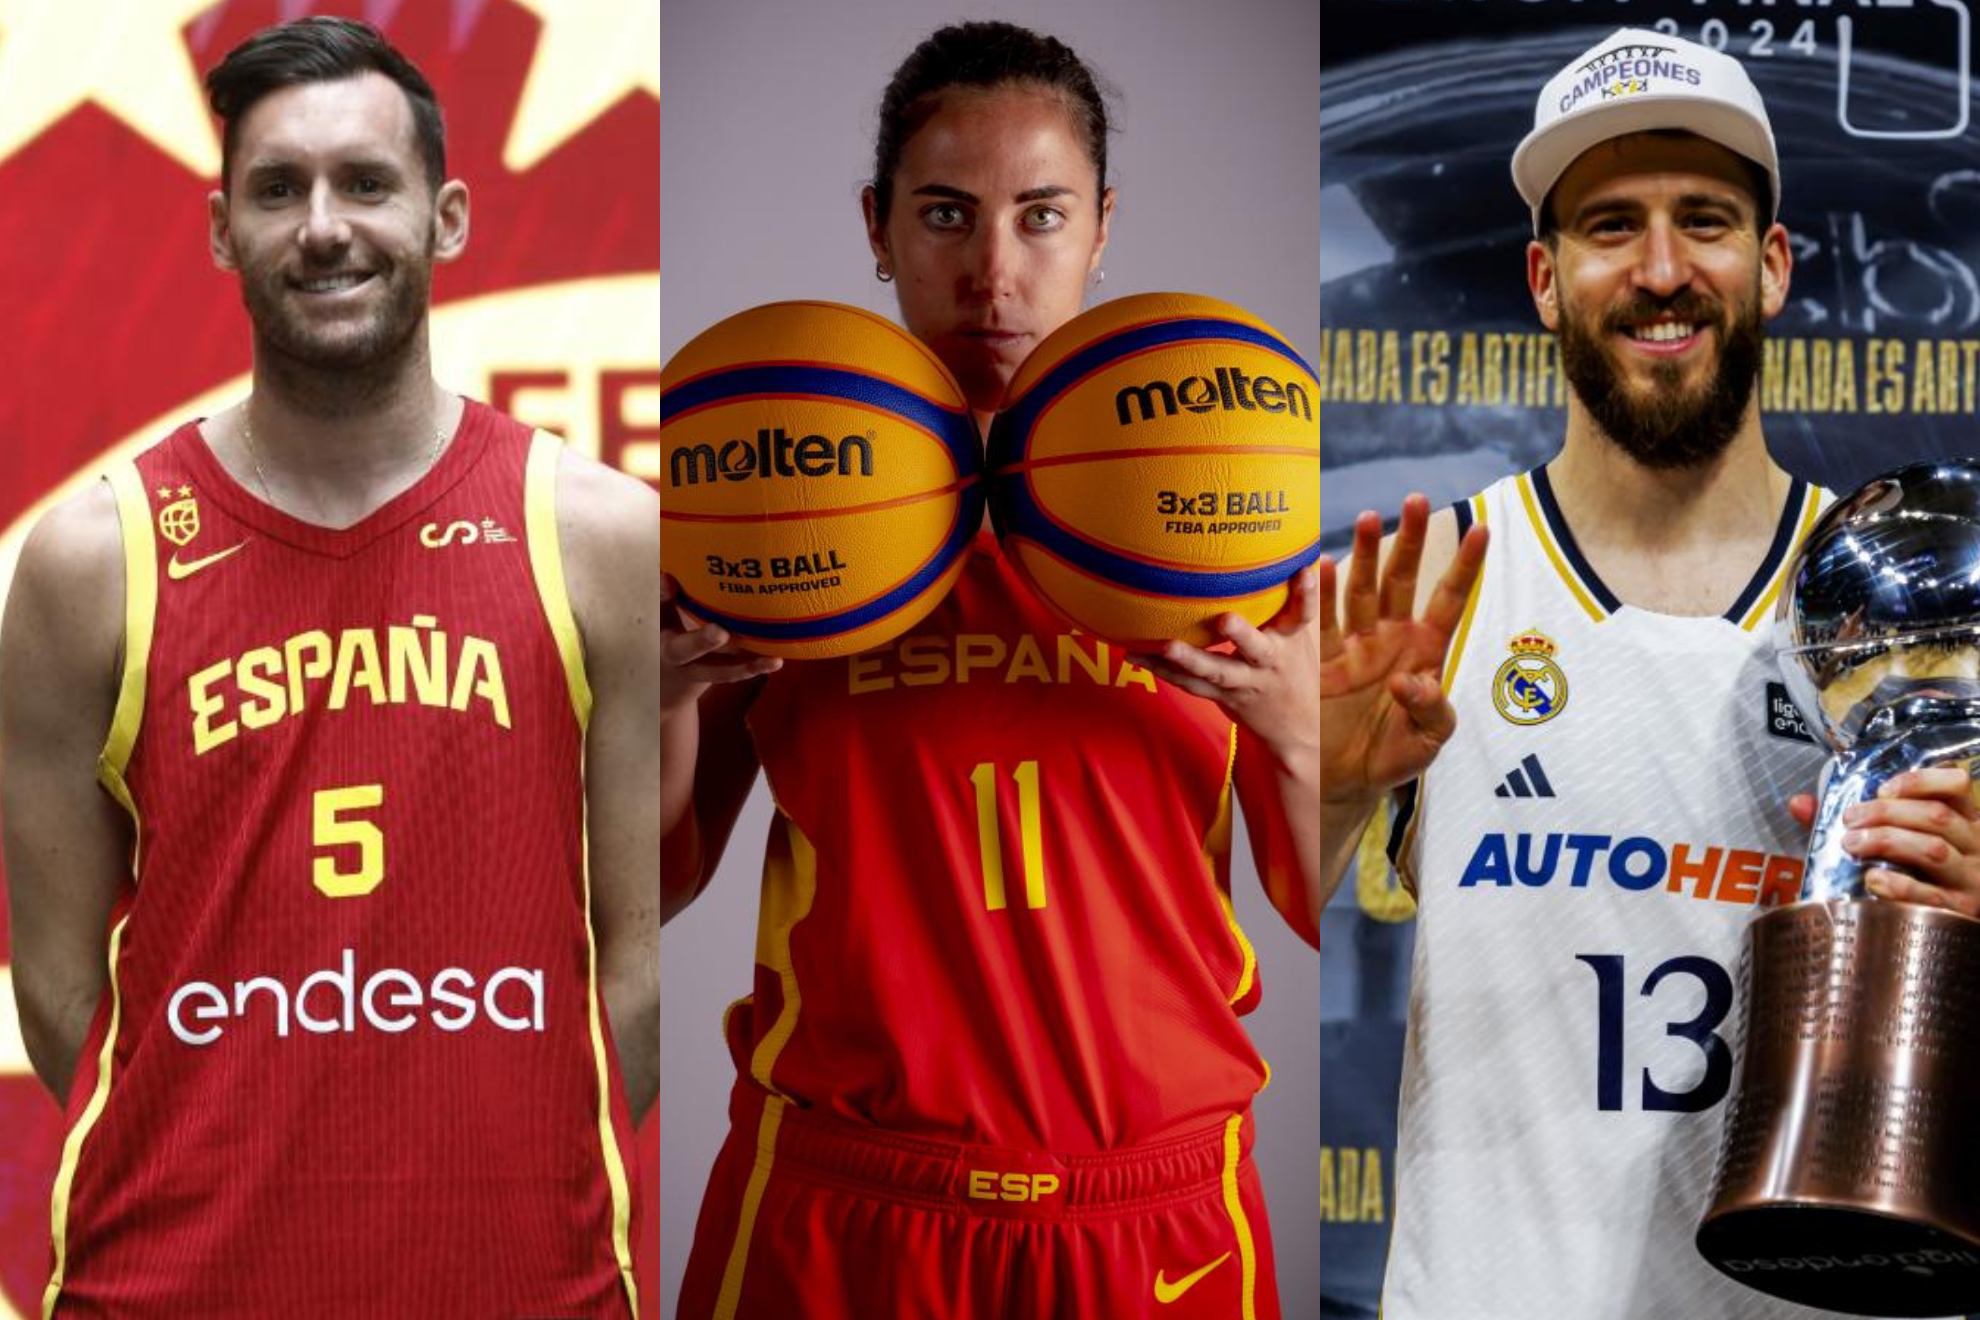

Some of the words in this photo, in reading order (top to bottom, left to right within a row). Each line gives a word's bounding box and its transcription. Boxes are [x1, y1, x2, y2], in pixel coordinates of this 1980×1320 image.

[1560, 59, 1701, 113] CAMPEONES
[1115, 367, 1312, 426] molten
[1411, 330, 1449, 405] ES
[1761, 338, 1857, 412] NADA
[1866, 339, 1905, 413] ES
[670, 429, 874, 488] molten
[1157, 491, 1219, 516] 3x3
[1226, 491, 1289, 516] BALL
[1165, 521, 1204, 534] FIBA
[1207, 519, 1282, 534] APPROVED
[706, 555, 763, 579] 3x3
[770, 550, 847, 578] BALL
[719, 581, 755, 594] FIBA
[758, 576, 841, 595] APPROVED
[188, 614, 511, 755] ESPAÑA
[313, 784, 384, 897] 5
[970, 760, 1047, 910] 11
[167, 949, 544, 1045] endesa
[1575, 955, 1734, 1113] 13
[969, 1170, 1060, 1201] ESP
